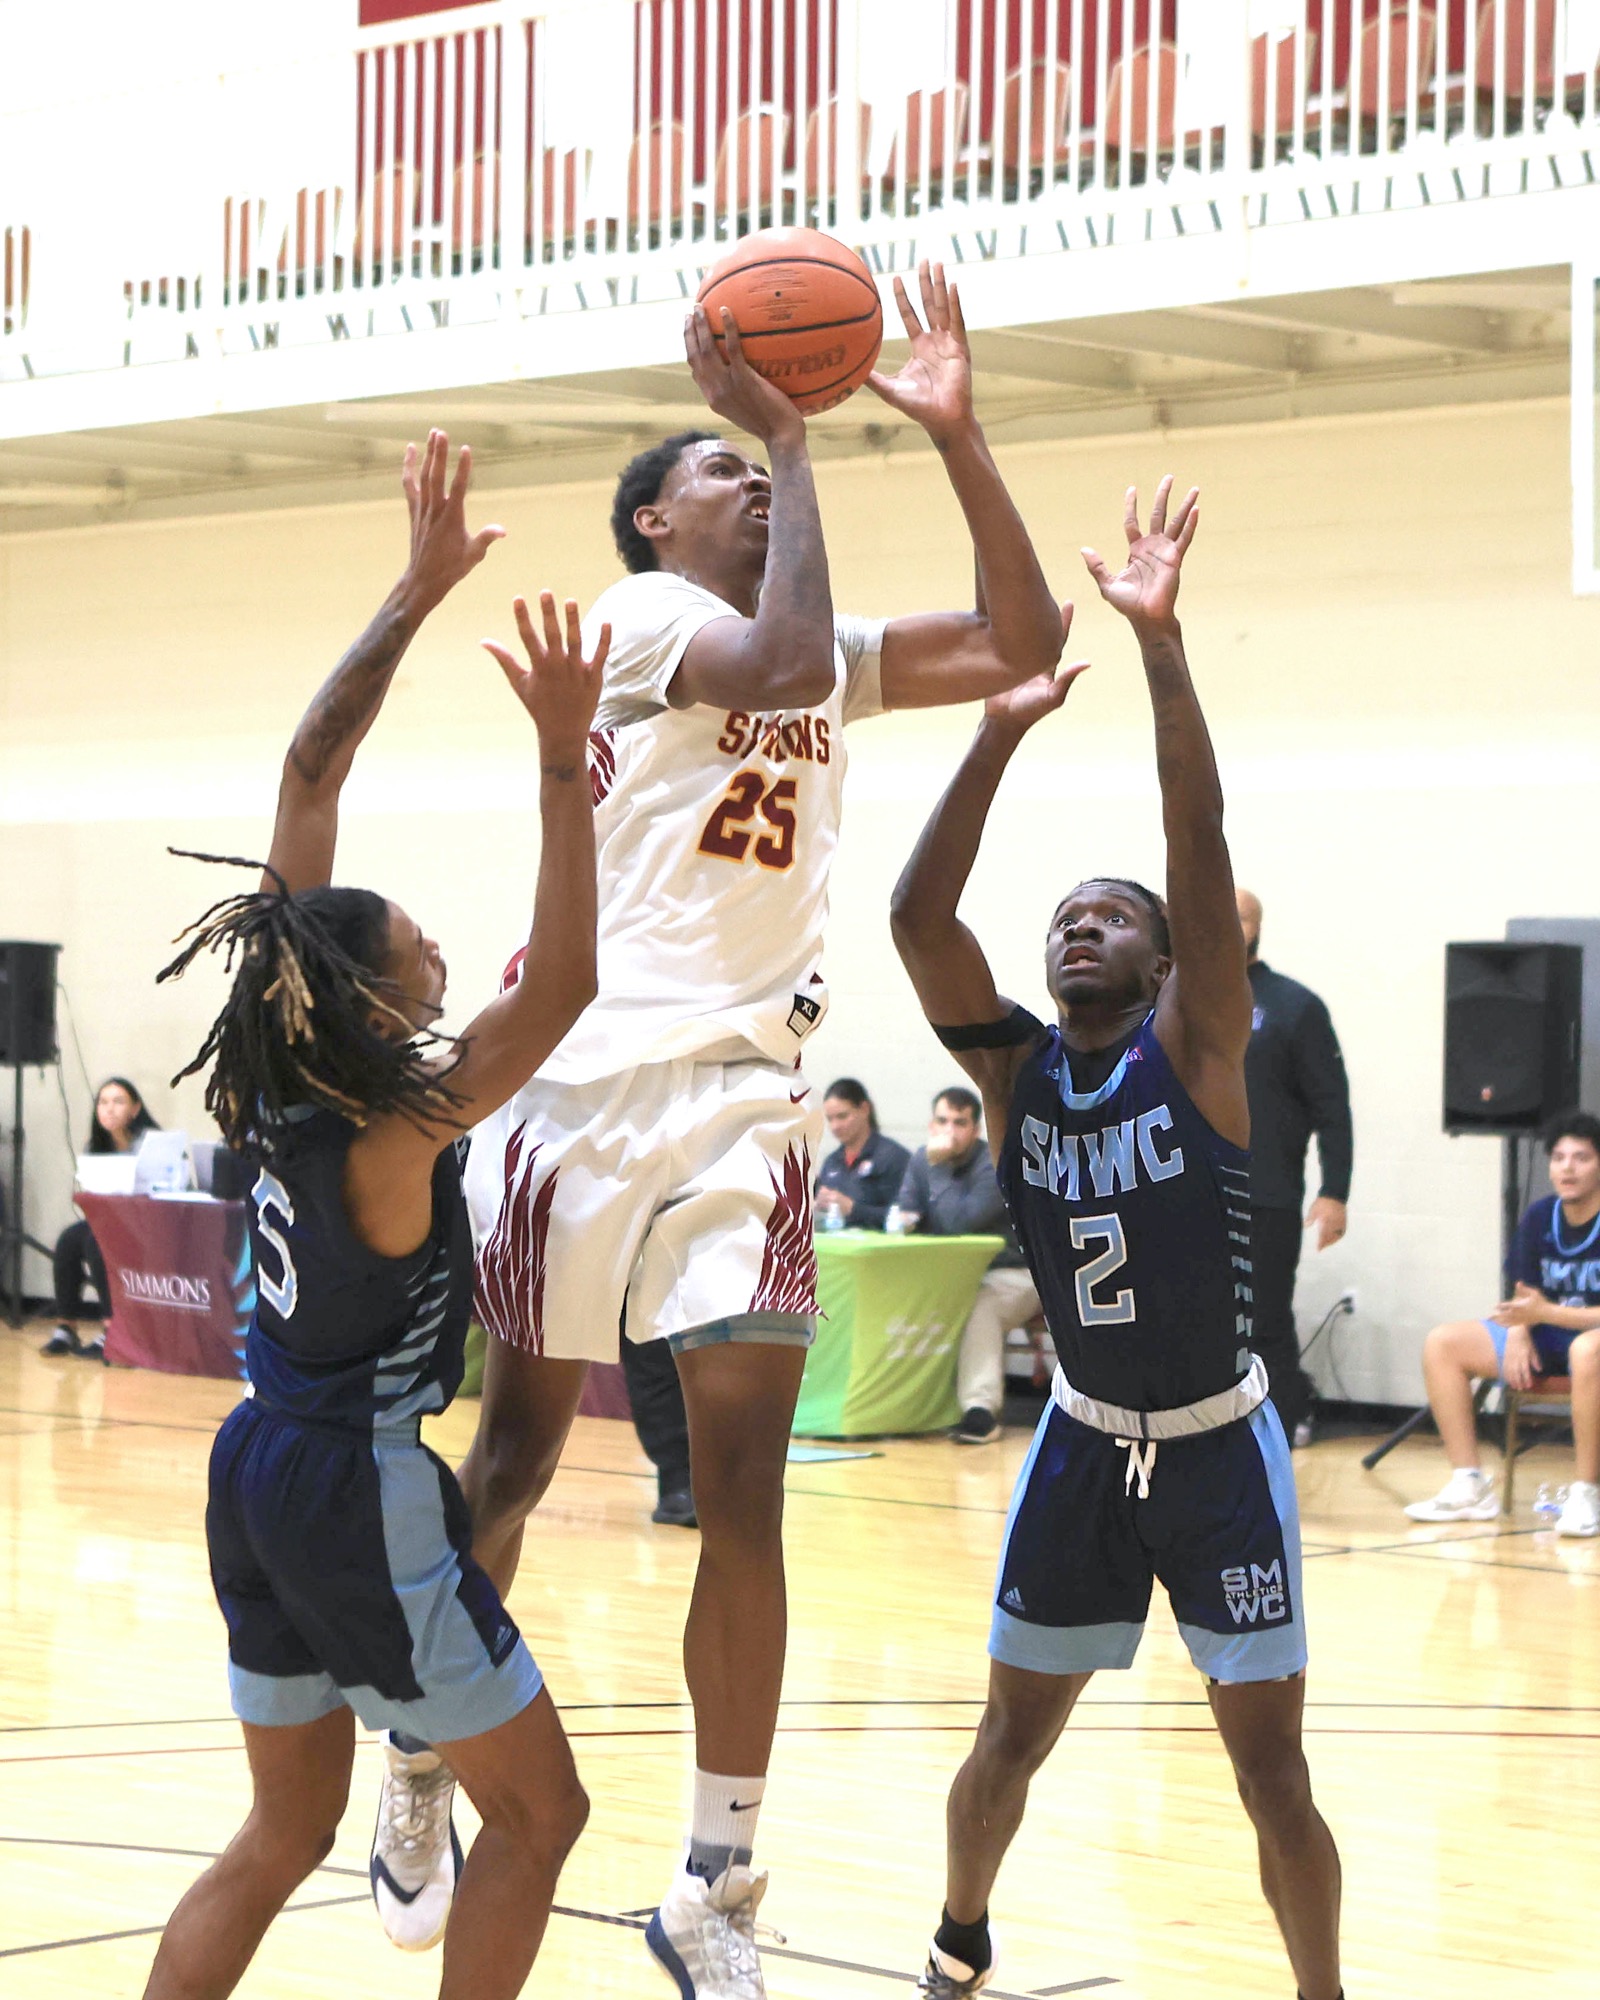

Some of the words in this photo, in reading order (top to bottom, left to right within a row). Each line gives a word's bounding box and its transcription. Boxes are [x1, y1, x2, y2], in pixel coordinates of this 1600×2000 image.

[696, 767, 798, 873] 25
[801, 1000, 814, 1018] XL
[1020, 1103, 1185, 1201] SMWC
[120, 1268, 211, 1304] SIMMONS
[1069, 1212, 1136, 1327] 2
[1220, 1558, 1283, 1592] SM
[1225, 1592, 1286, 1625] WC
